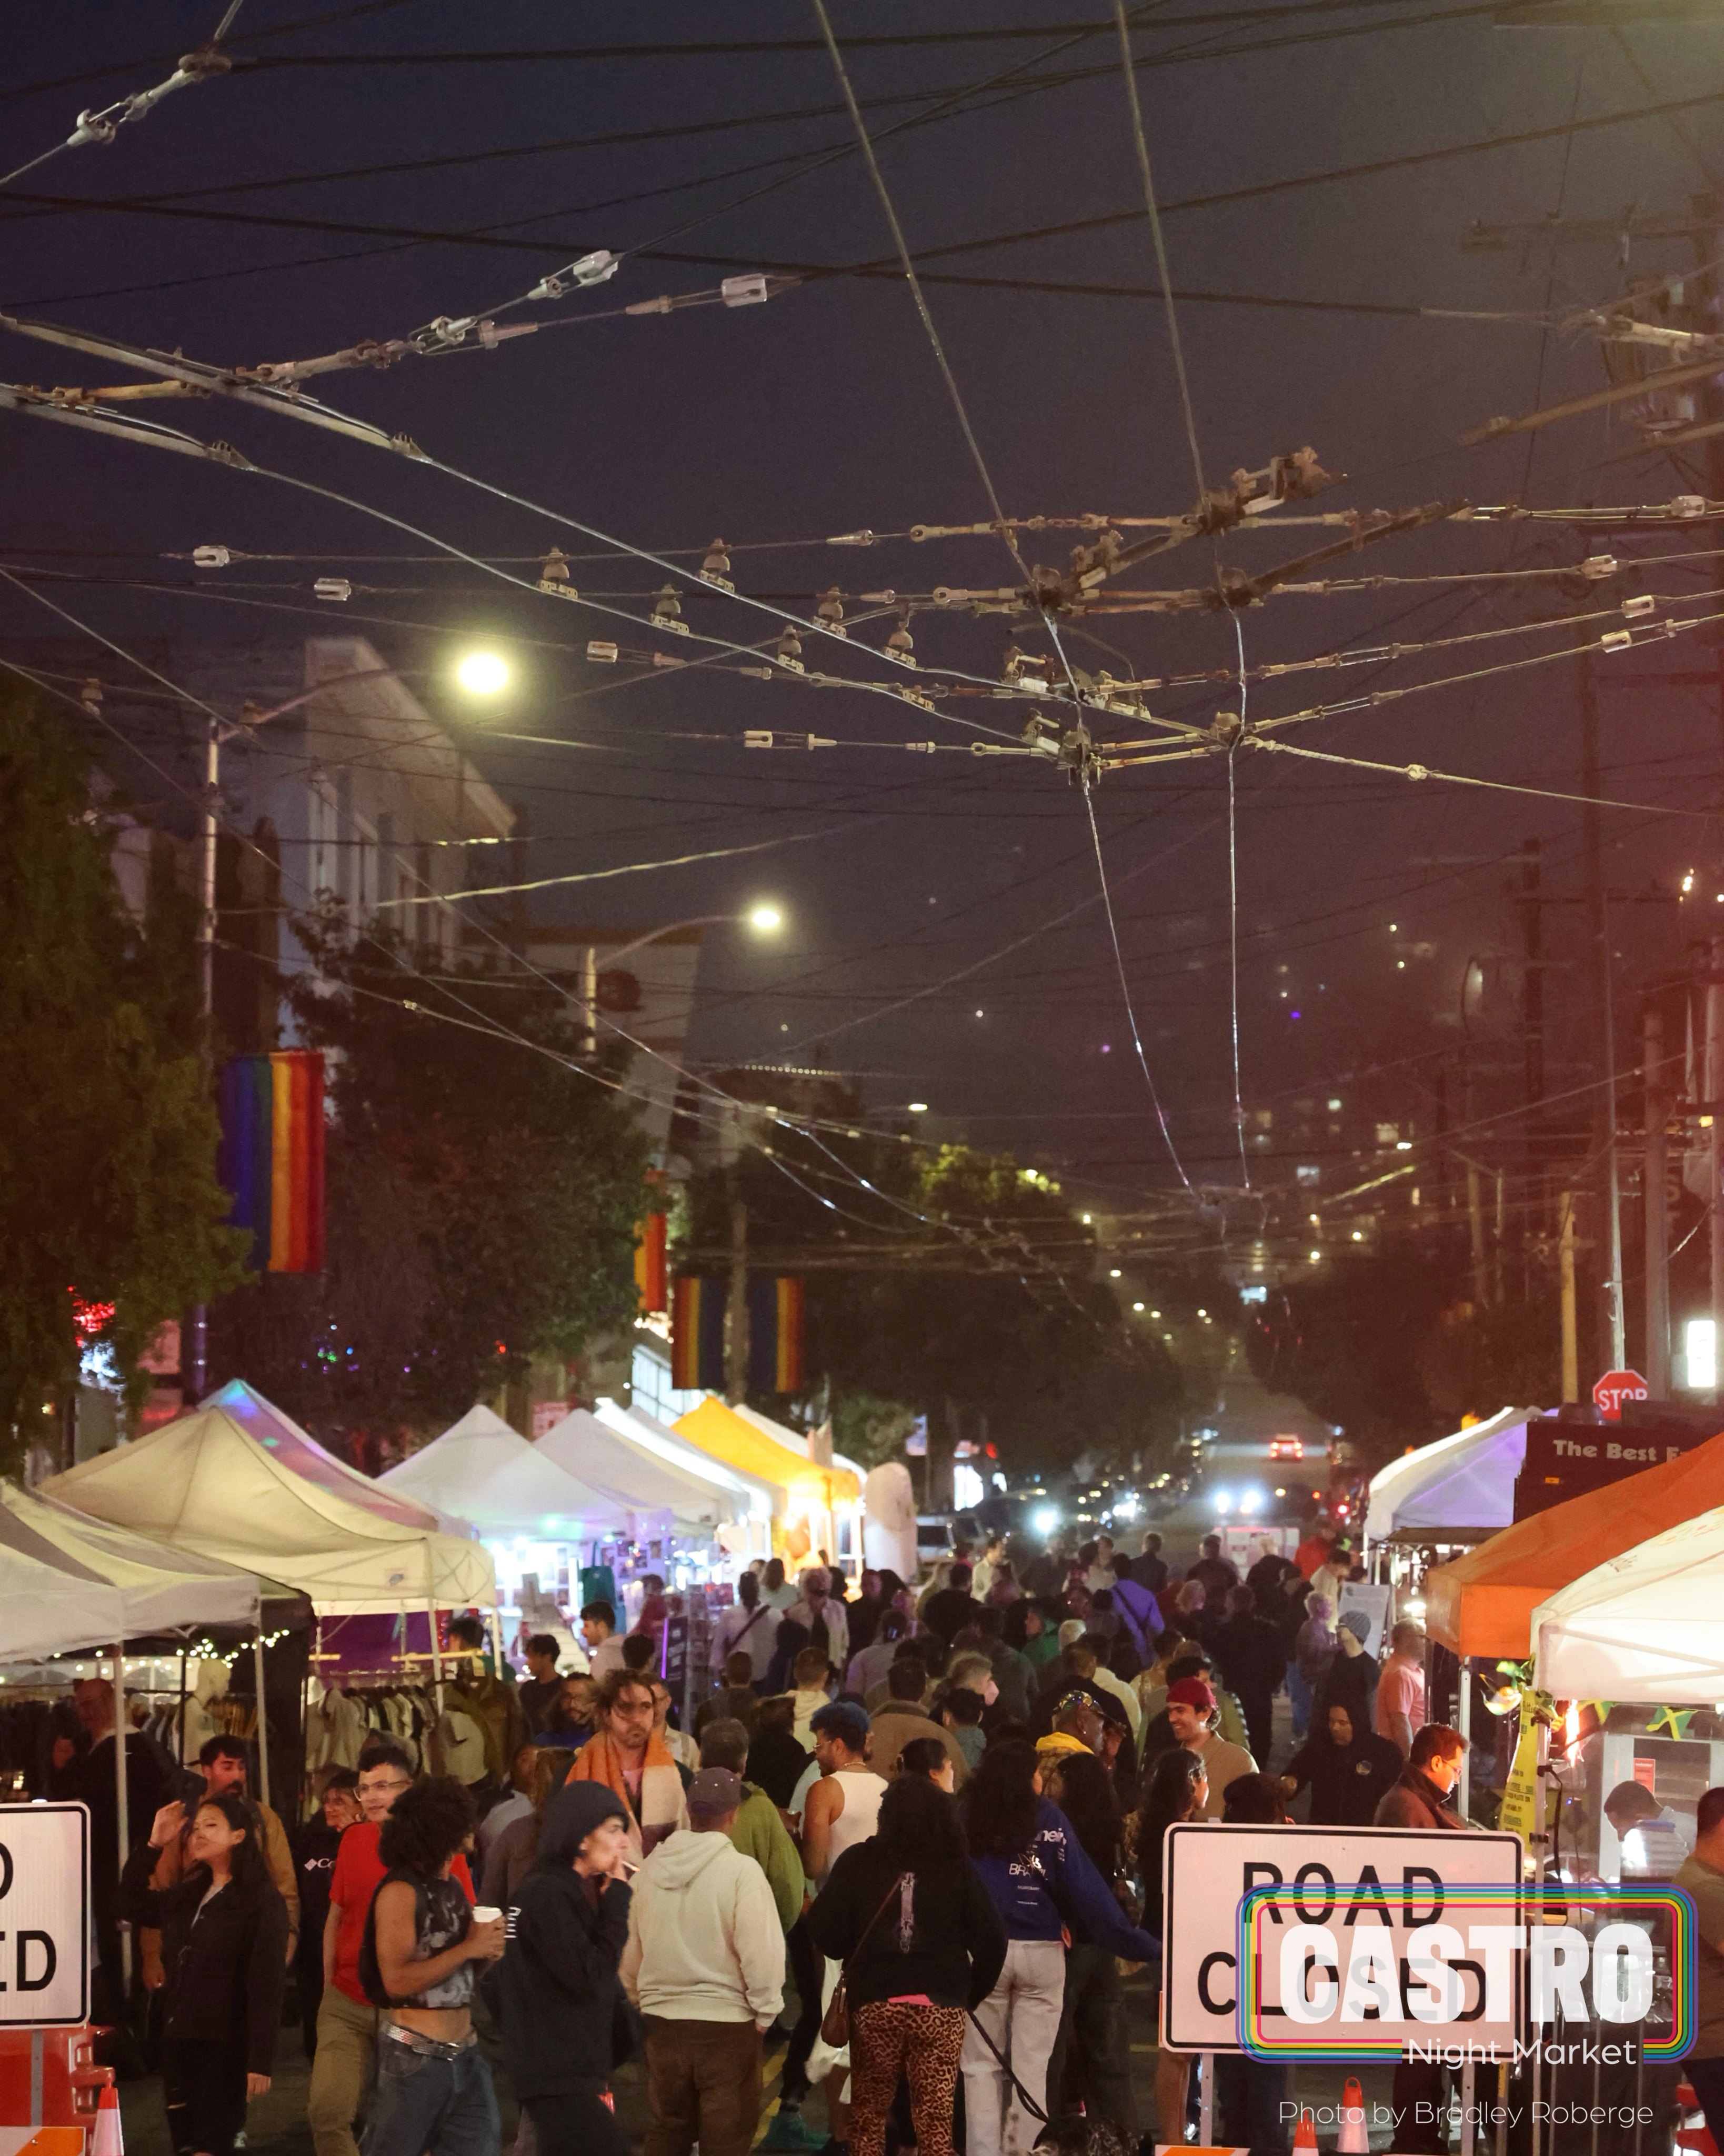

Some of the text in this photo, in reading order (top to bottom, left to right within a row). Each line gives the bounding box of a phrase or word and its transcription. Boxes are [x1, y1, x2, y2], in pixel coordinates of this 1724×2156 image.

[1553, 1440, 1598, 1458] The
[1607, 1443, 1657, 1462] Best
[1242, 1861, 1445, 1928] ROAD
[1197, 1951, 1490, 2022] CLOSED
